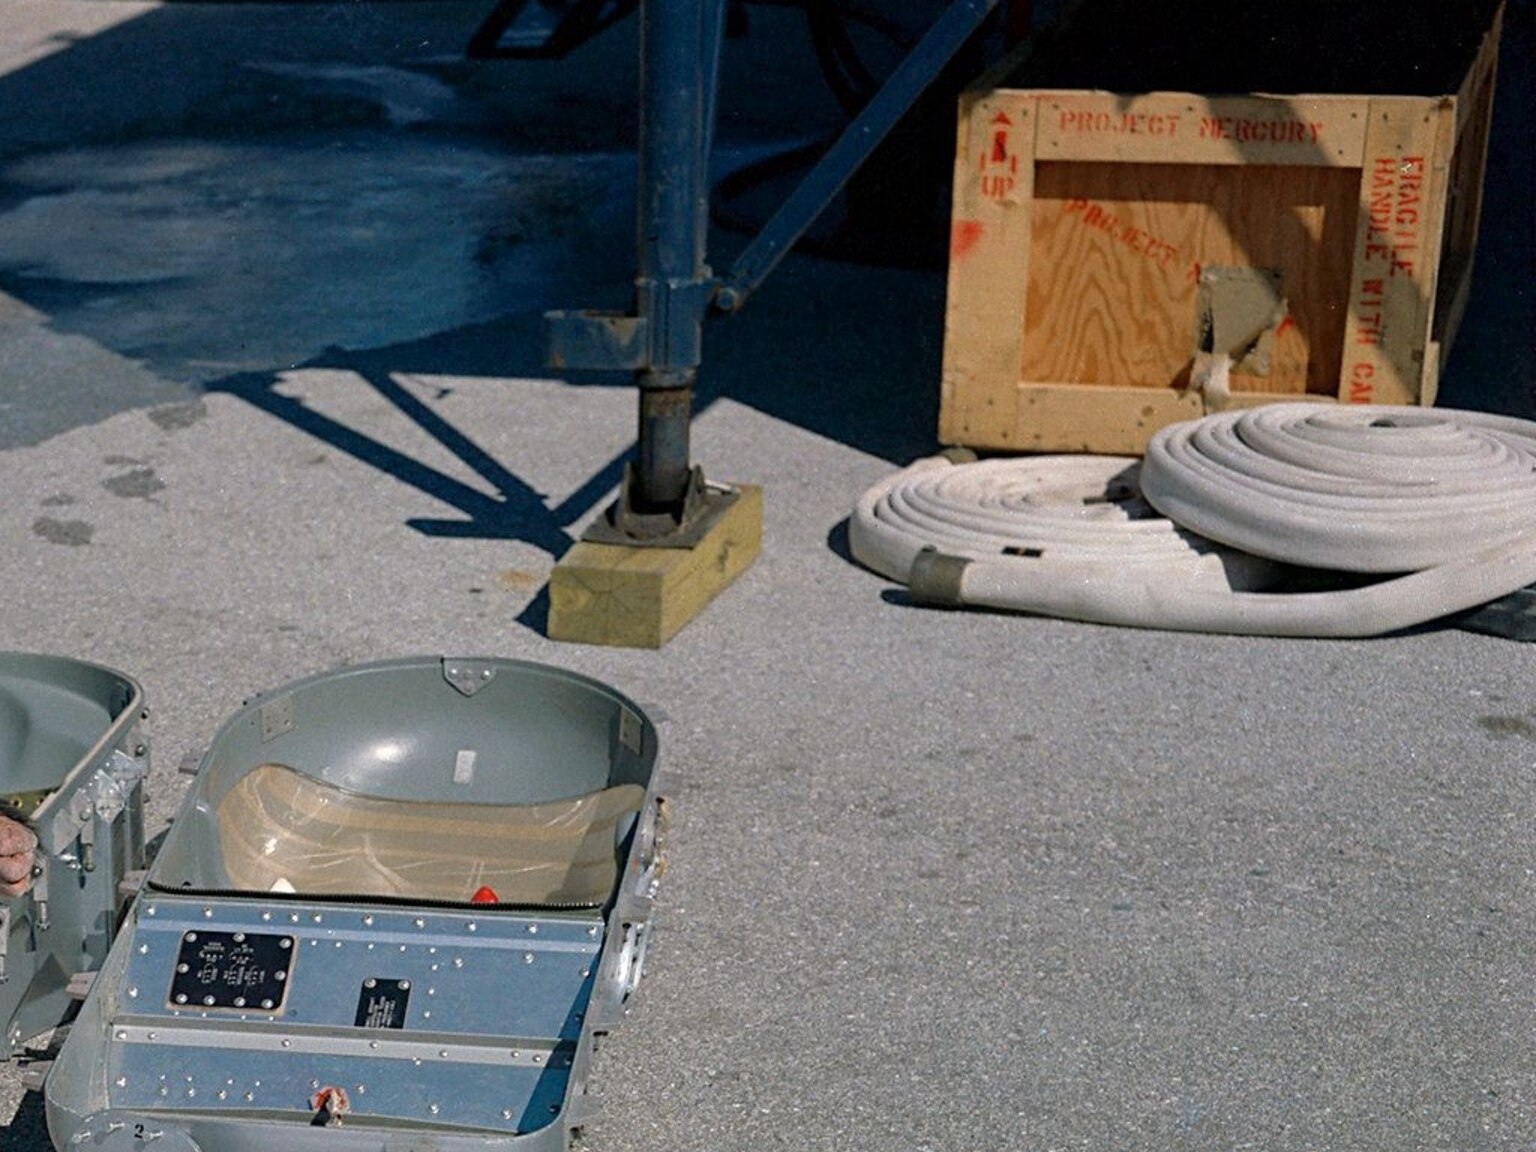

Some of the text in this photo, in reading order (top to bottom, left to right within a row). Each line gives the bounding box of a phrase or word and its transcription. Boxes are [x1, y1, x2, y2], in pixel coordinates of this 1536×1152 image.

[1060, 110, 1322, 145] PROJECT MERCURY
[981, 175, 1013, 198] UP
[1365, 158, 1396, 261] HANDLE
[1389, 156, 1424, 278] FRAGILE
[1356, 279, 1383, 346] WITH
